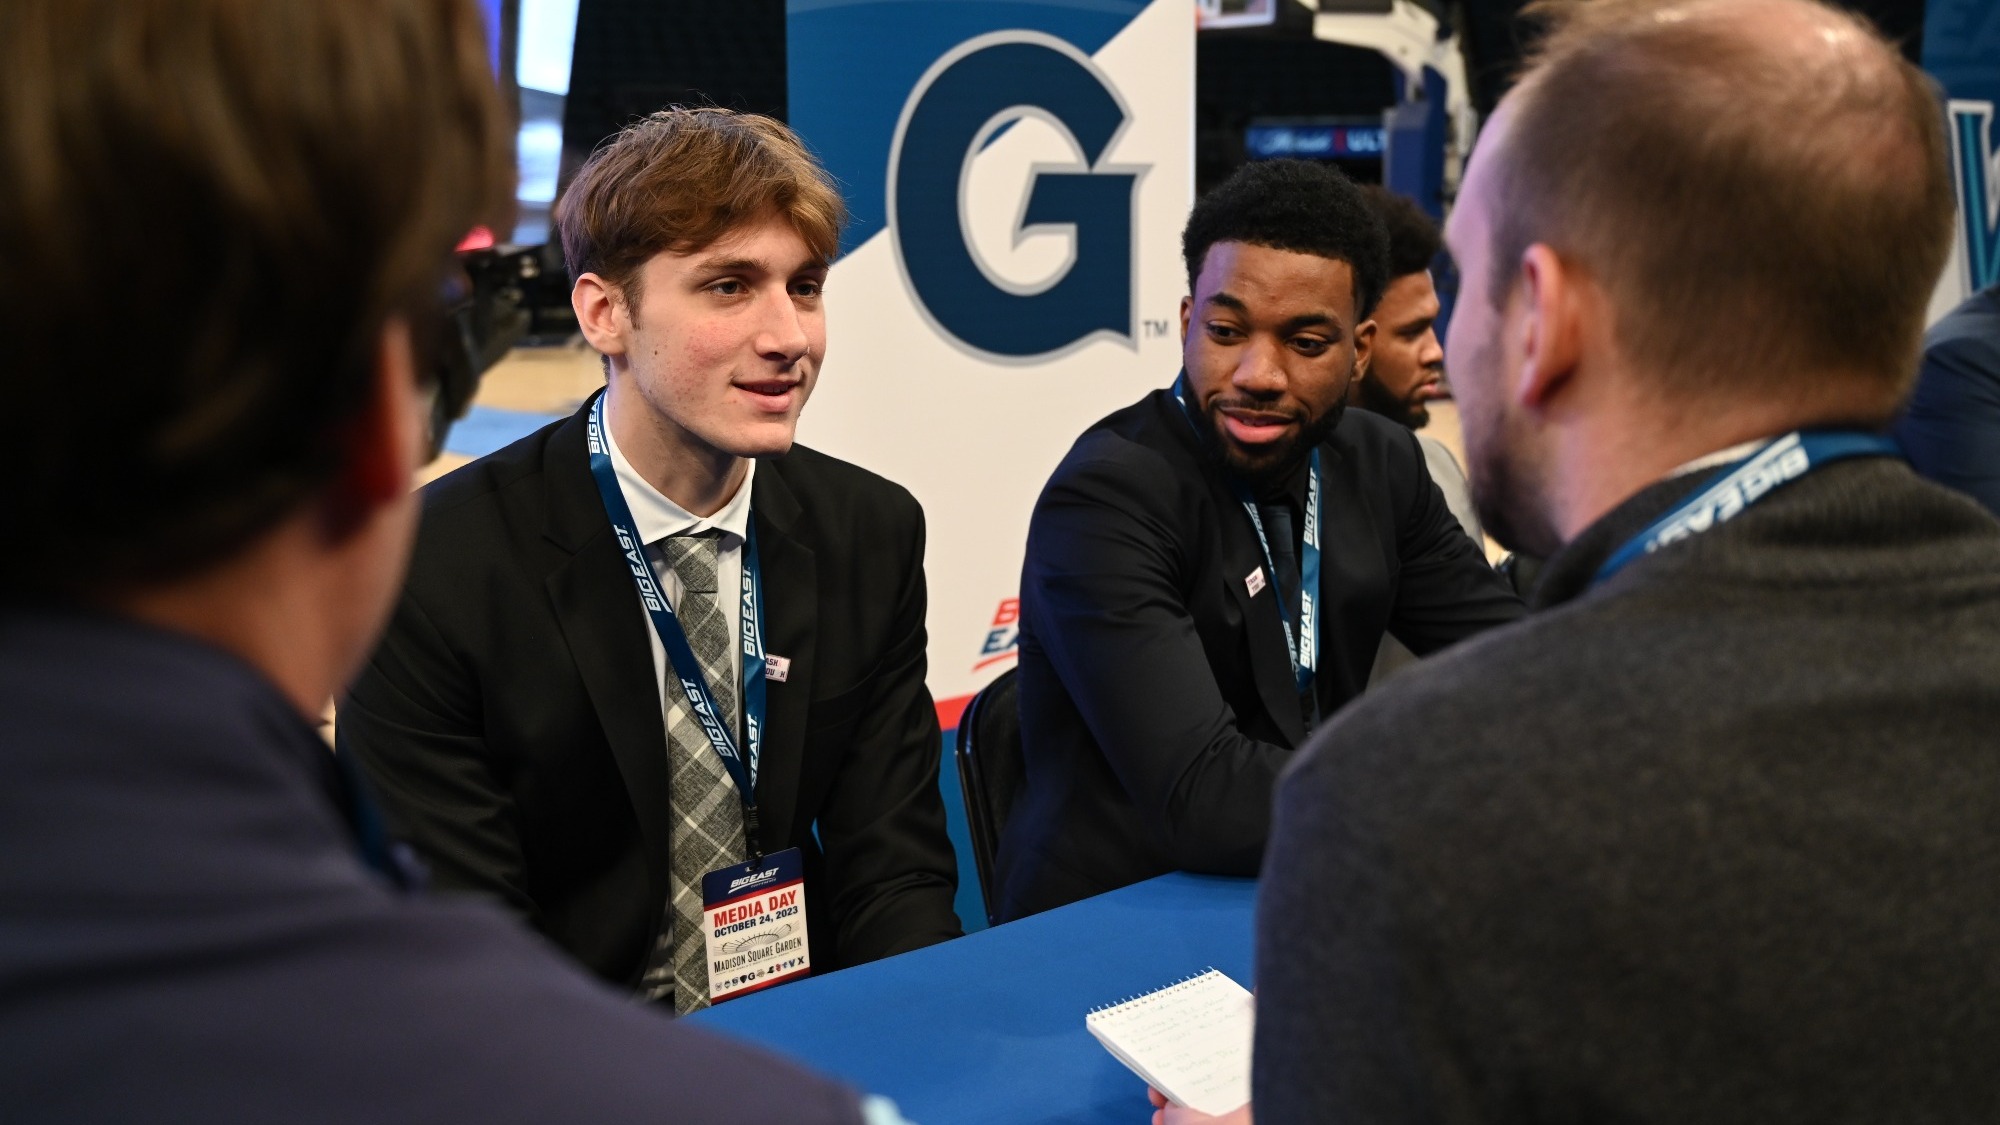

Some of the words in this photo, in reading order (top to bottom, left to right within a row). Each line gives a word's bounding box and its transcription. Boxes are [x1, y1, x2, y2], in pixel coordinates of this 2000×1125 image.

[886, 29, 1154, 367] G
[1143, 321, 1168, 338] TM
[714, 900, 764, 928] MEDIA
[768, 890, 797, 911] DAY
[714, 918, 756, 938] OCTOBER
[759, 914, 774, 924] 24,
[776, 905, 798, 919] 2023
[714, 954, 746, 973] MADISON
[747, 944, 774, 963] SQUARE
[775, 936, 802, 954] GARDEN
